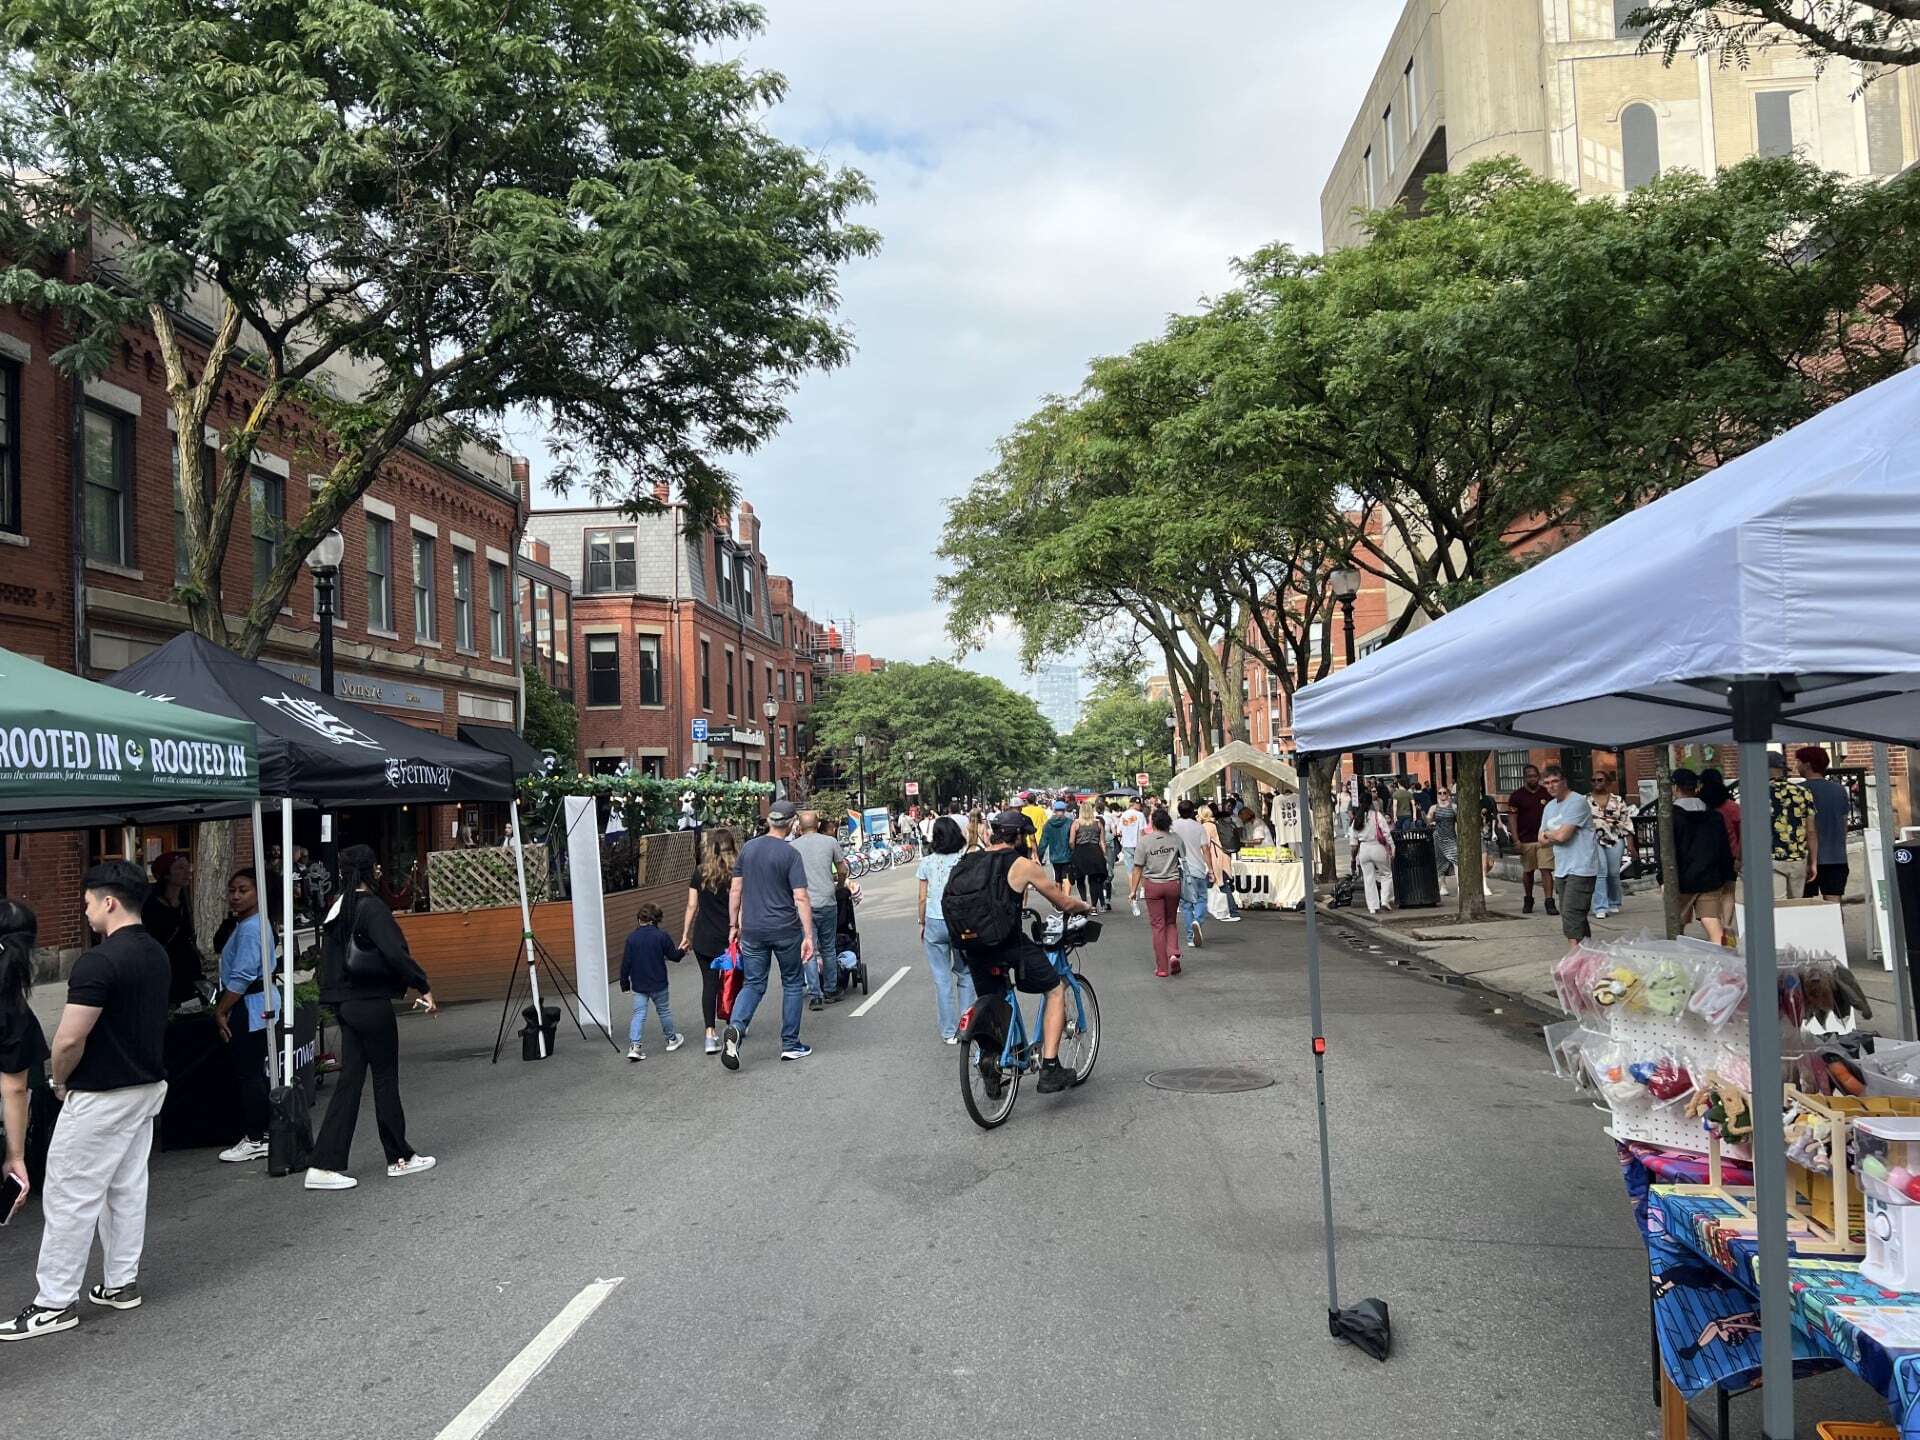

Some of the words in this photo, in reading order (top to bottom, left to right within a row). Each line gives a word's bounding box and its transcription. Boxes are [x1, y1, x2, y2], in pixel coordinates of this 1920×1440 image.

[96, 732, 122, 771] IN
[149, 738, 225, 775] ROOTED
[228, 744, 247, 777] IN
[399, 758, 454, 792] Fernway
[1150, 845, 1175, 856] union
